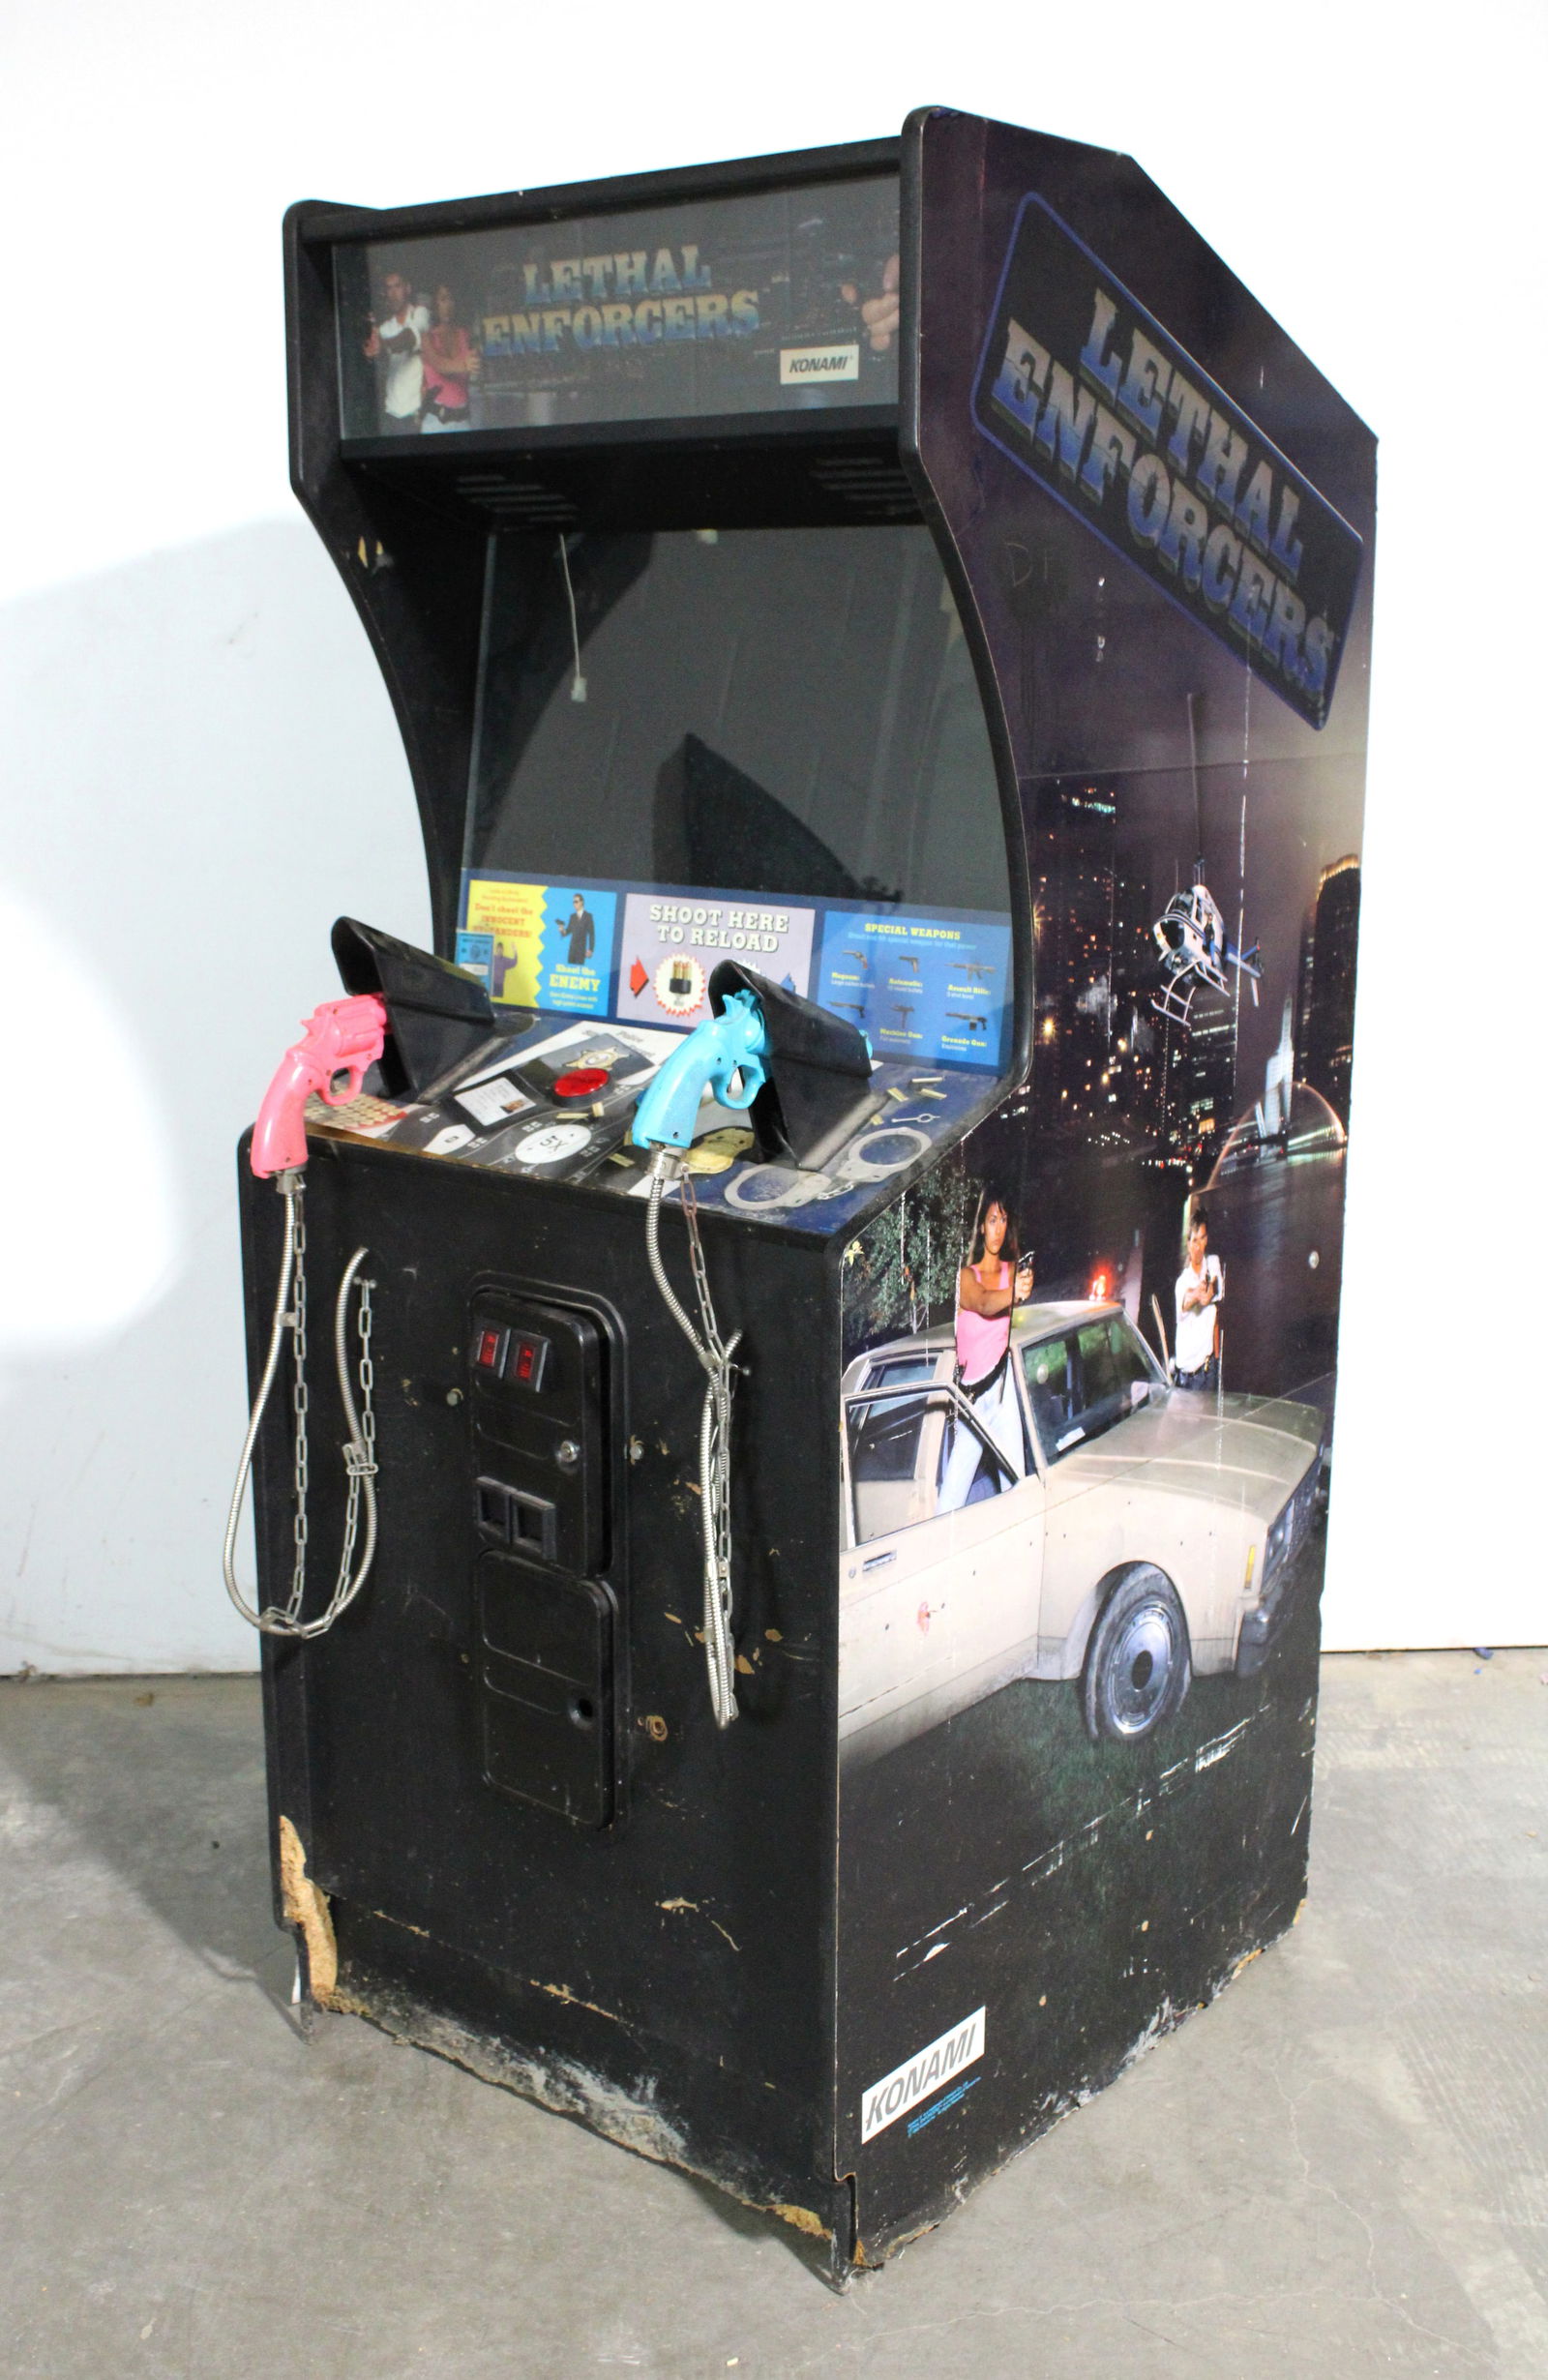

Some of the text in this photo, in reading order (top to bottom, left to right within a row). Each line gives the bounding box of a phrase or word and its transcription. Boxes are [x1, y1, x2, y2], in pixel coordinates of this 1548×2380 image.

[522, 245, 713, 306] LETHAL
[484, 289, 760, 357] ENFORCERS
[789, 355, 848, 374] KONAMI
[1060, 286, 1303, 579] LETHAL
[990, 317, 1335, 697] ENFORCERS
[649, 904, 789, 934] SHOOT HERE
[658, 924, 779, 954] TO RELOAD
[865, 922, 908, 936] SPECIAL
[910, 927, 962, 941] WEAPONS
[550, 972, 601, 992] ENEMY
[865, 2023, 976, 2132] KONAMI
